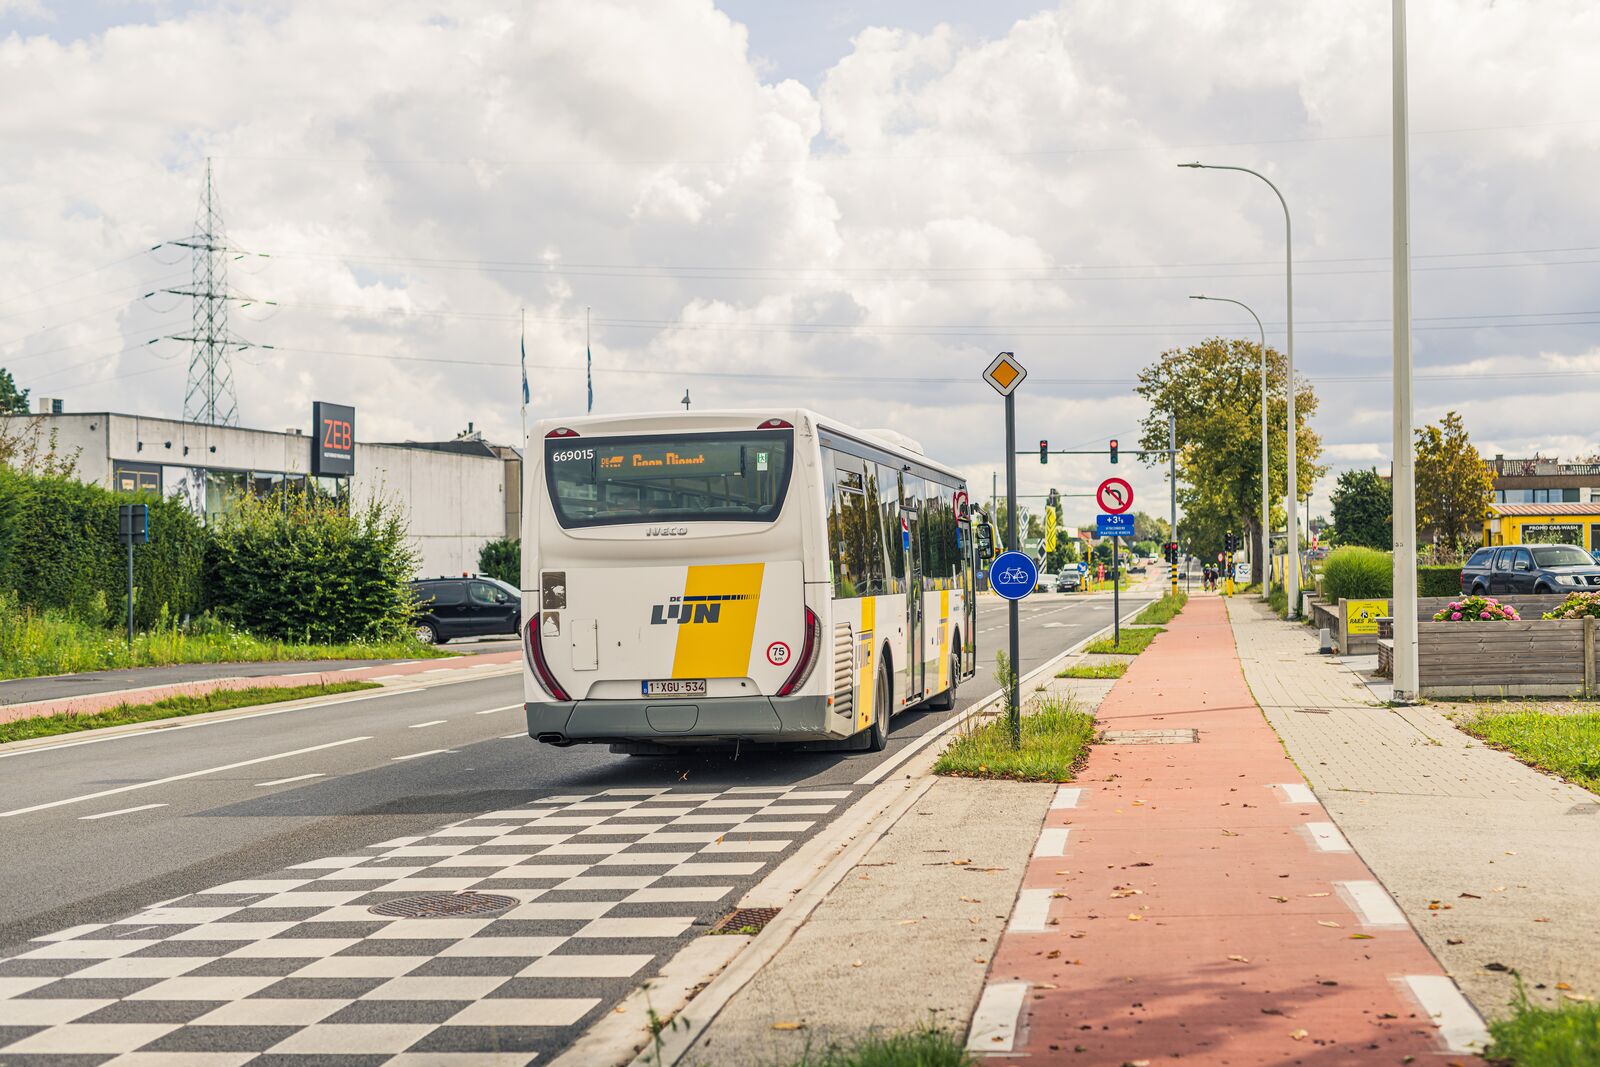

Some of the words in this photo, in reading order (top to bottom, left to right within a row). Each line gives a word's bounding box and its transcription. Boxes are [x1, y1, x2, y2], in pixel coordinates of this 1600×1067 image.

[323, 419, 352, 450] ZEB
[553, 449, 594, 462] 669015
[646, 527, 688, 537] IVECO
[650, 603, 721, 625] LIJN
[772, 647, 785, 656] 75
